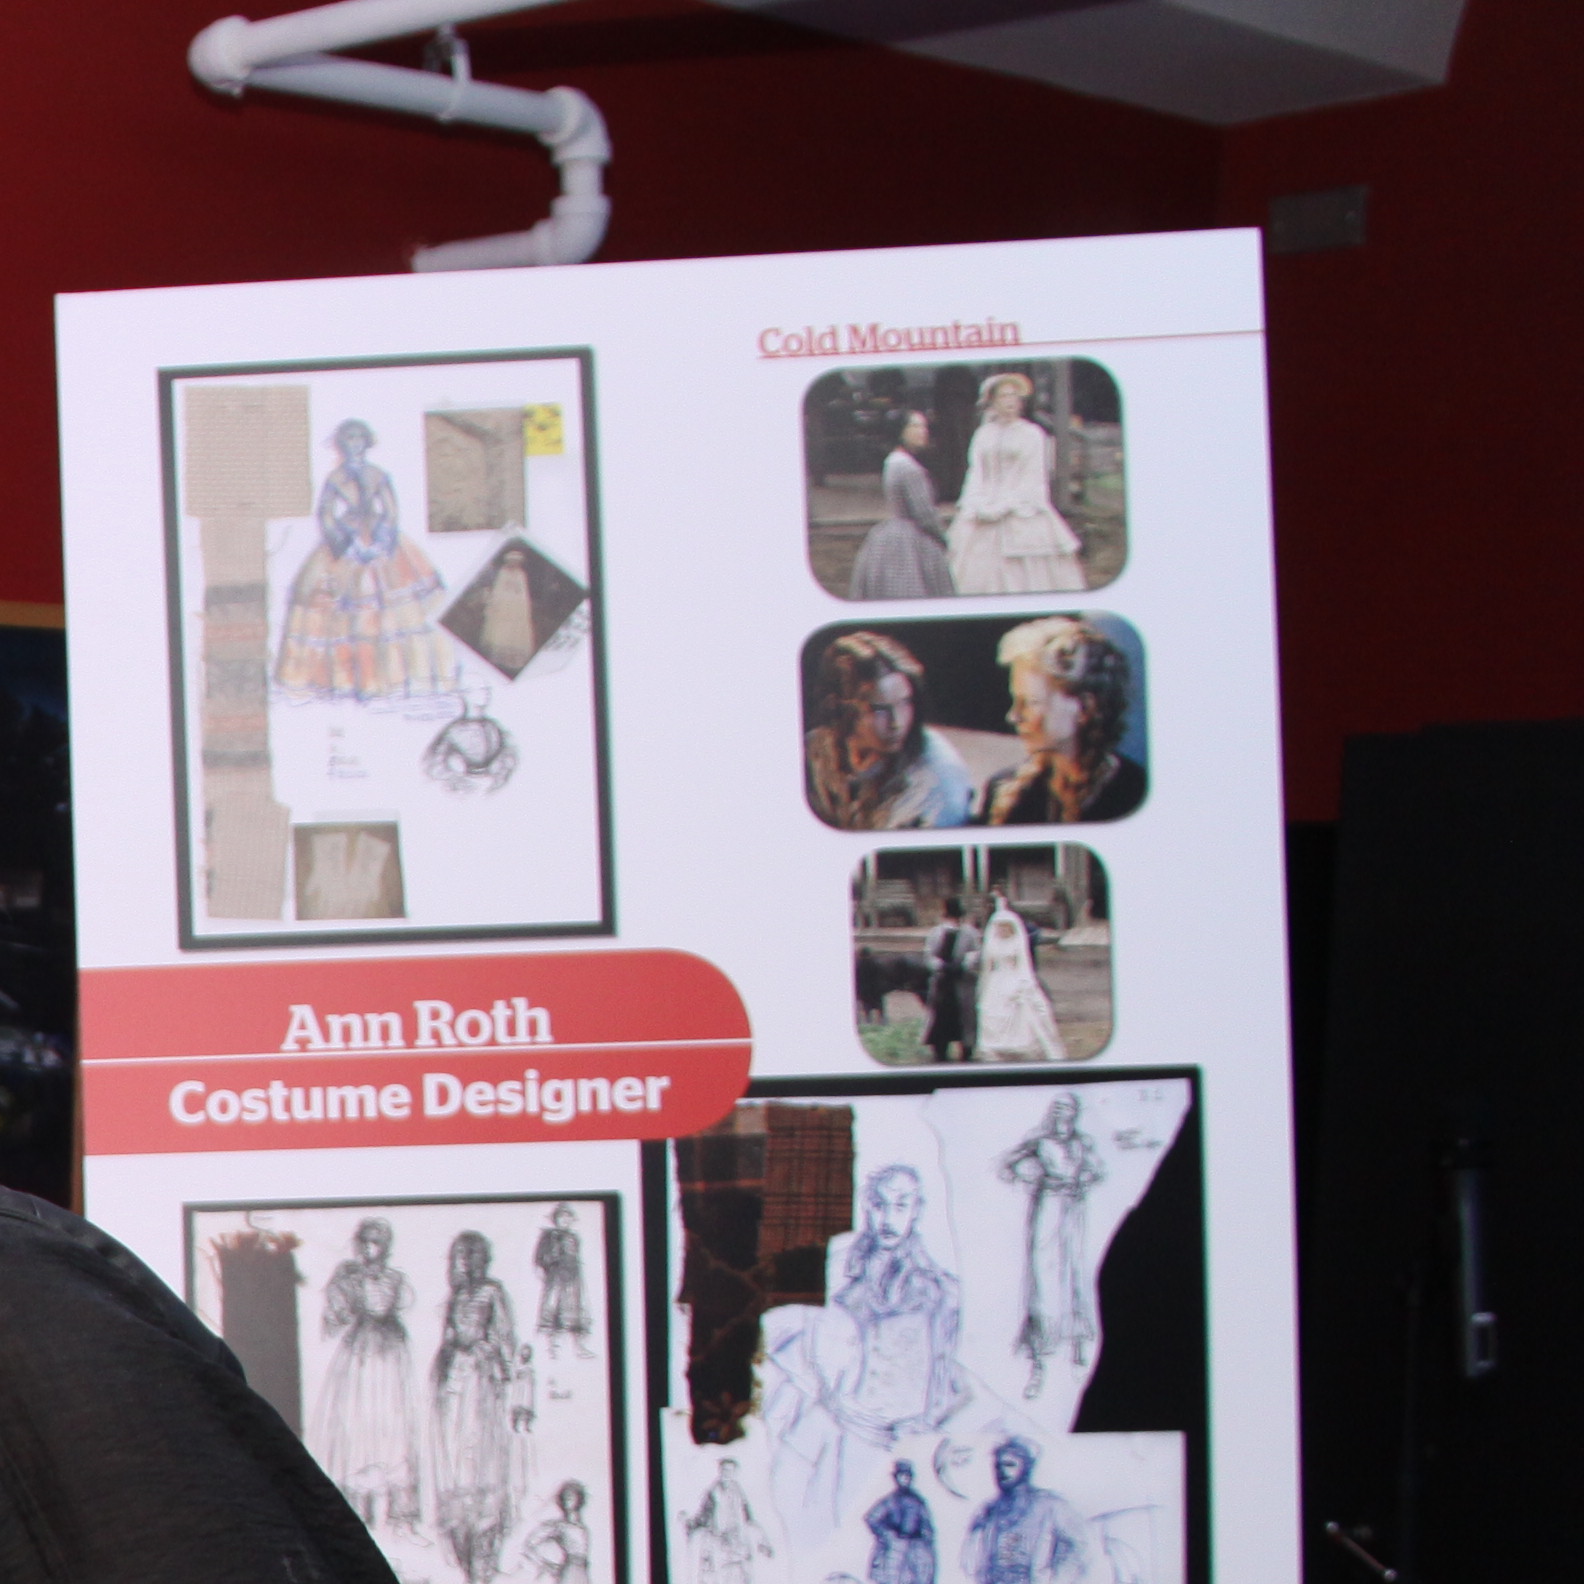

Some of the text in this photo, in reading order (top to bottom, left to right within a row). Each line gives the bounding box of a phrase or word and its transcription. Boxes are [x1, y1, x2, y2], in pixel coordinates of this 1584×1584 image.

[757, 316, 1021, 356] Cold Mountain
[279, 996, 553, 1051] Ann Roth
[168, 1068, 670, 1125] Costume Designer
